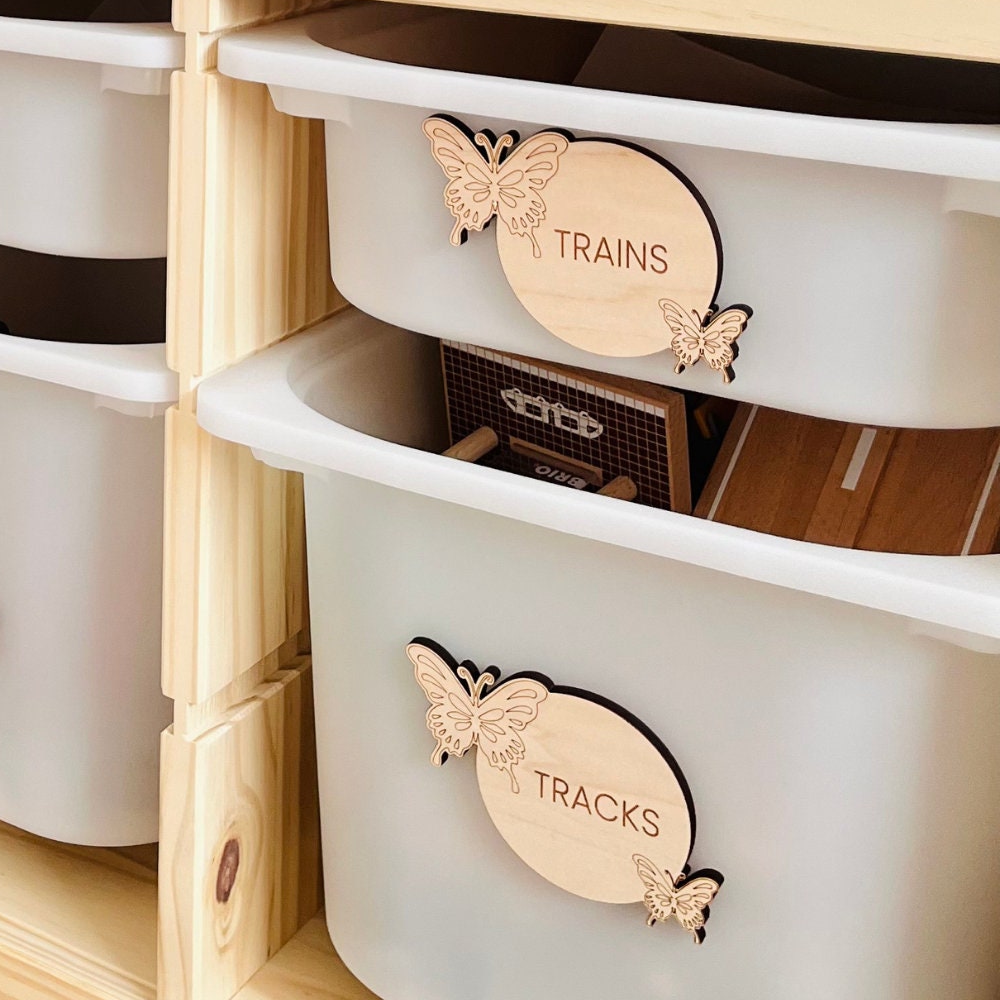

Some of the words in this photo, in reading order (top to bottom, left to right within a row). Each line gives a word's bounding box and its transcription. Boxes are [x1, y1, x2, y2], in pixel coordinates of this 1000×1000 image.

[554, 229, 669, 275] TRAINS
[535, 465, 588, 489] BRIO
[534, 770, 660, 838] TRACKS
